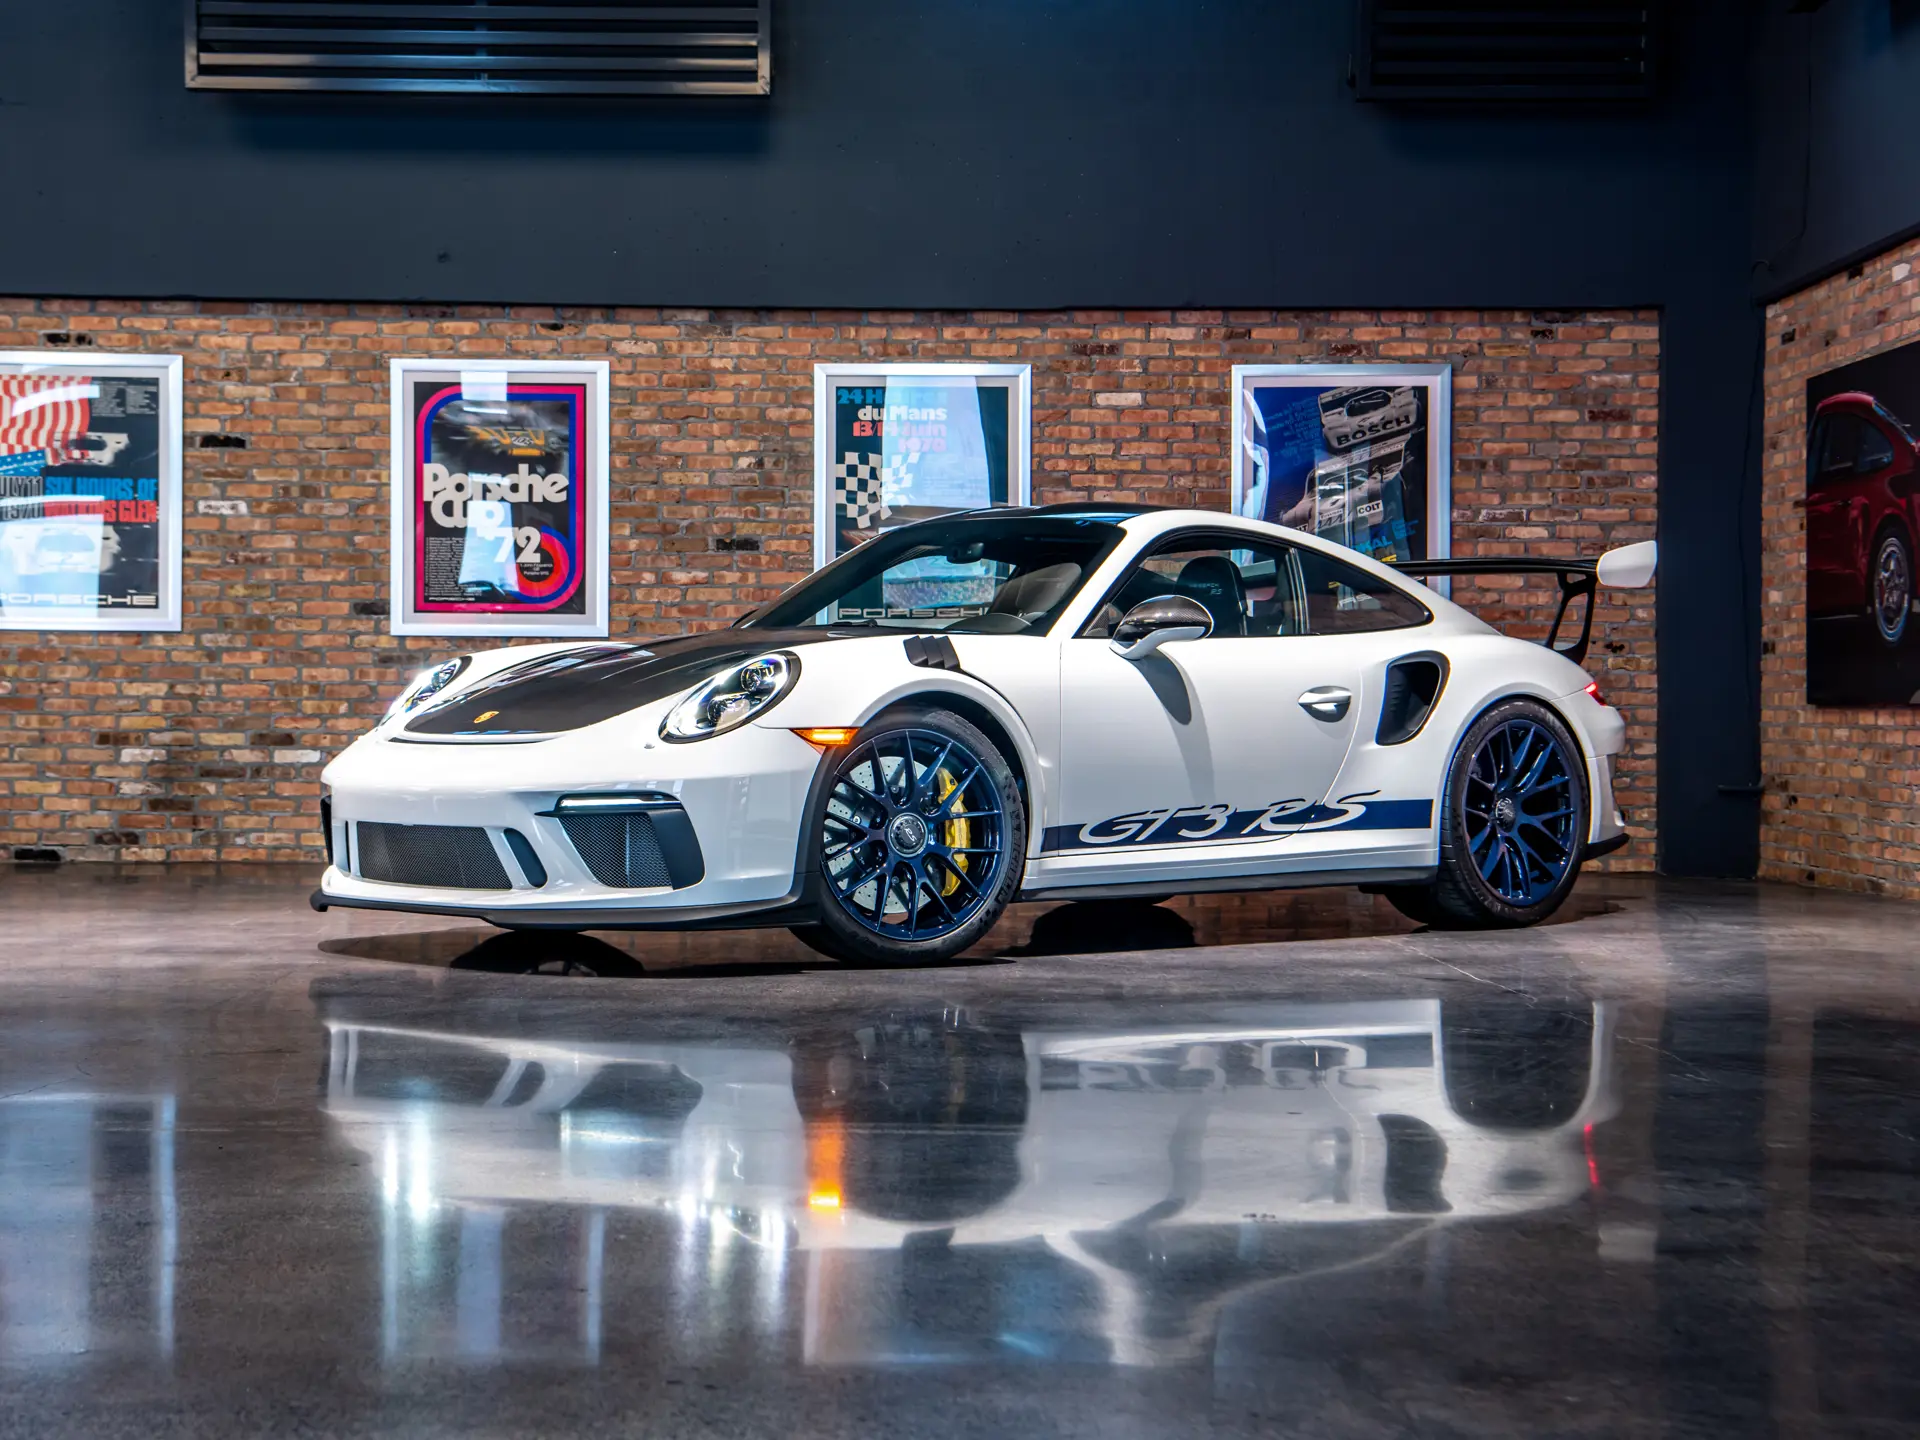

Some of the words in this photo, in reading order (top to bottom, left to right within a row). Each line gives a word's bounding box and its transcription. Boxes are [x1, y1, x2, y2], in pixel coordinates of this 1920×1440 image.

[837, 388, 864, 405] 24
[857, 405, 886, 421] du
[889, 405, 948, 421] Mans
[1336, 415, 1411, 446] BOSCH
[44, 476, 73, 497] SIX
[76, 477, 134, 501] HOURS
[138, 478, 158, 501] OF
[423, 463, 569, 503] Porsche
[119, 500, 157, 522] GLEN
[1358, 502, 1381, 514] COLT
[484, 525, 541, 563] 72
[0, 592, 157, 606] ORSCHE
[838, 608, 989, 620] PORSCH
[1079, 804, 1237, 844] GT3
[1241, 790, 1381, 834] RS
